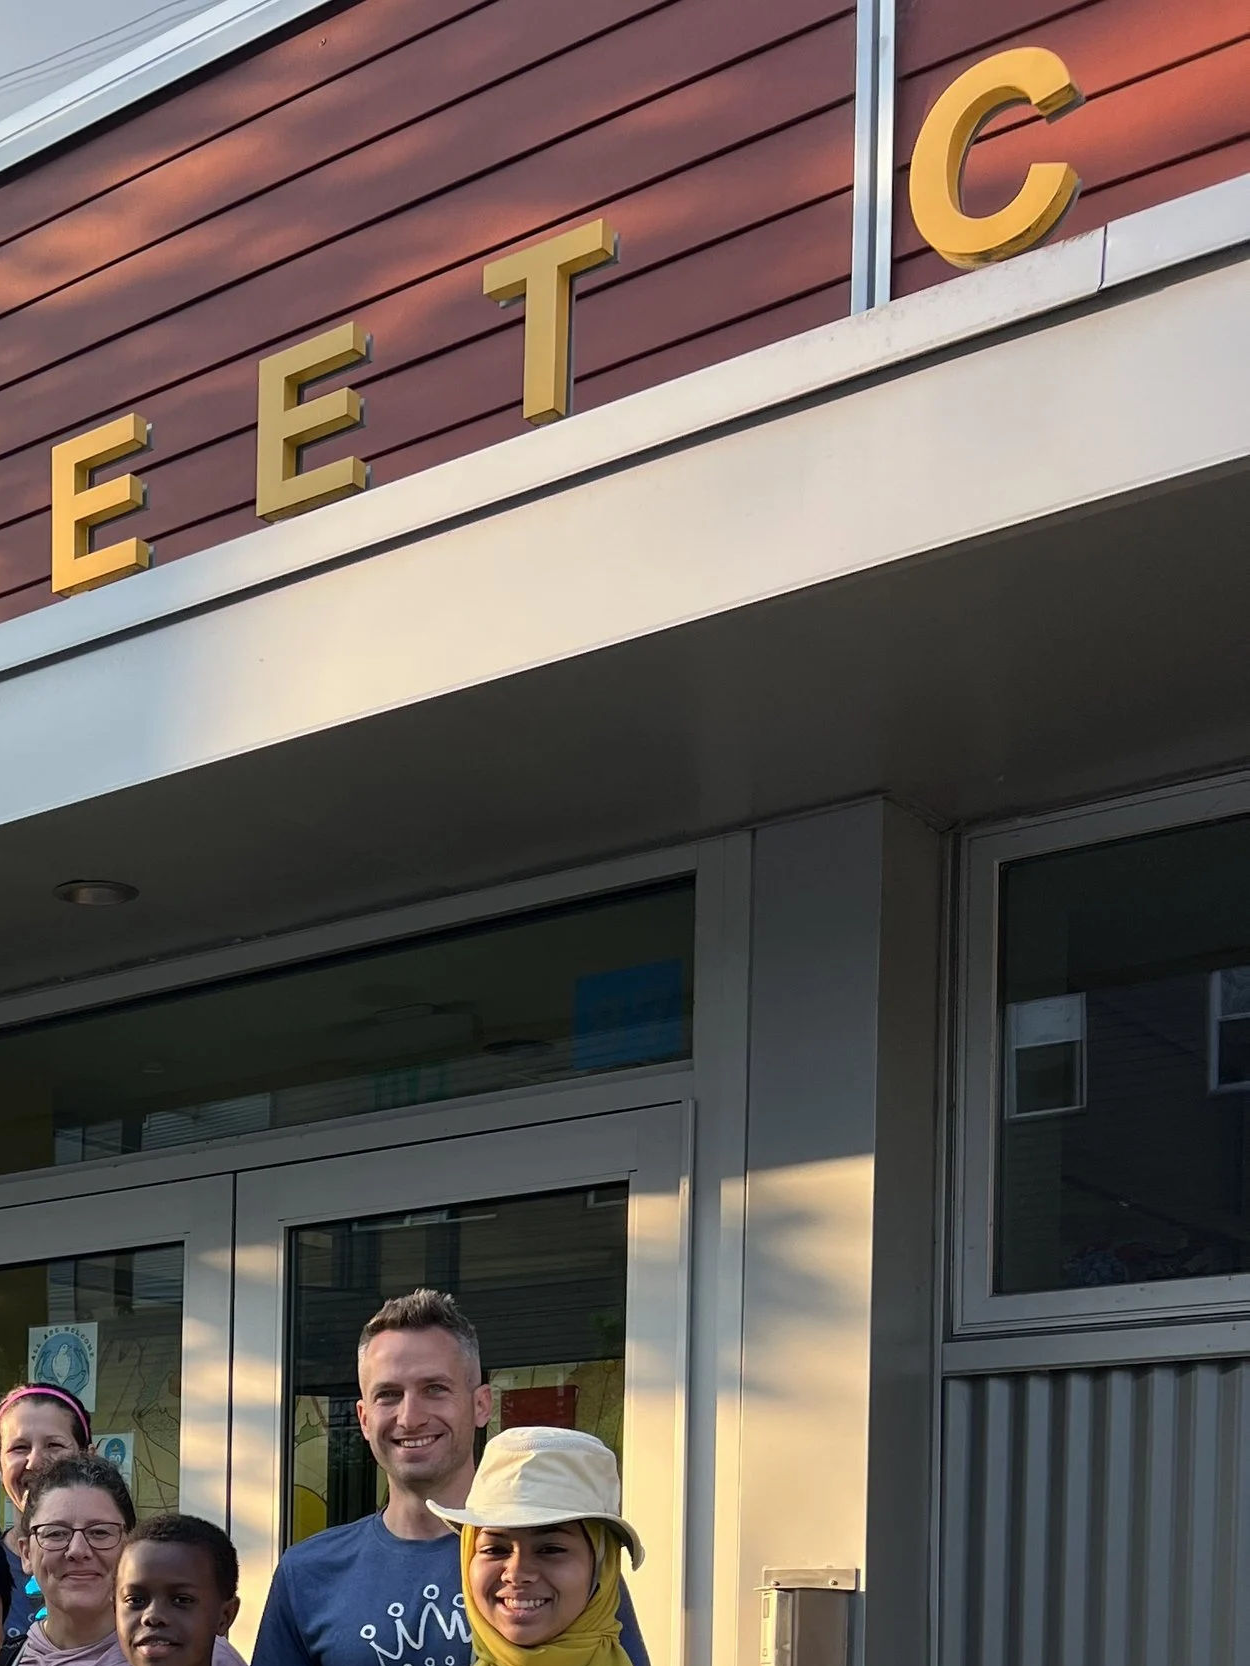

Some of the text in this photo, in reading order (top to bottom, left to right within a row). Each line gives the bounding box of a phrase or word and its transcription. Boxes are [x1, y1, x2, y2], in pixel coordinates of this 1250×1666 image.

[909, 45, 1083, 269] C
[43, 1327, 59, 1340] ARE
[64, 1326, 95, 1358] WELCOME
